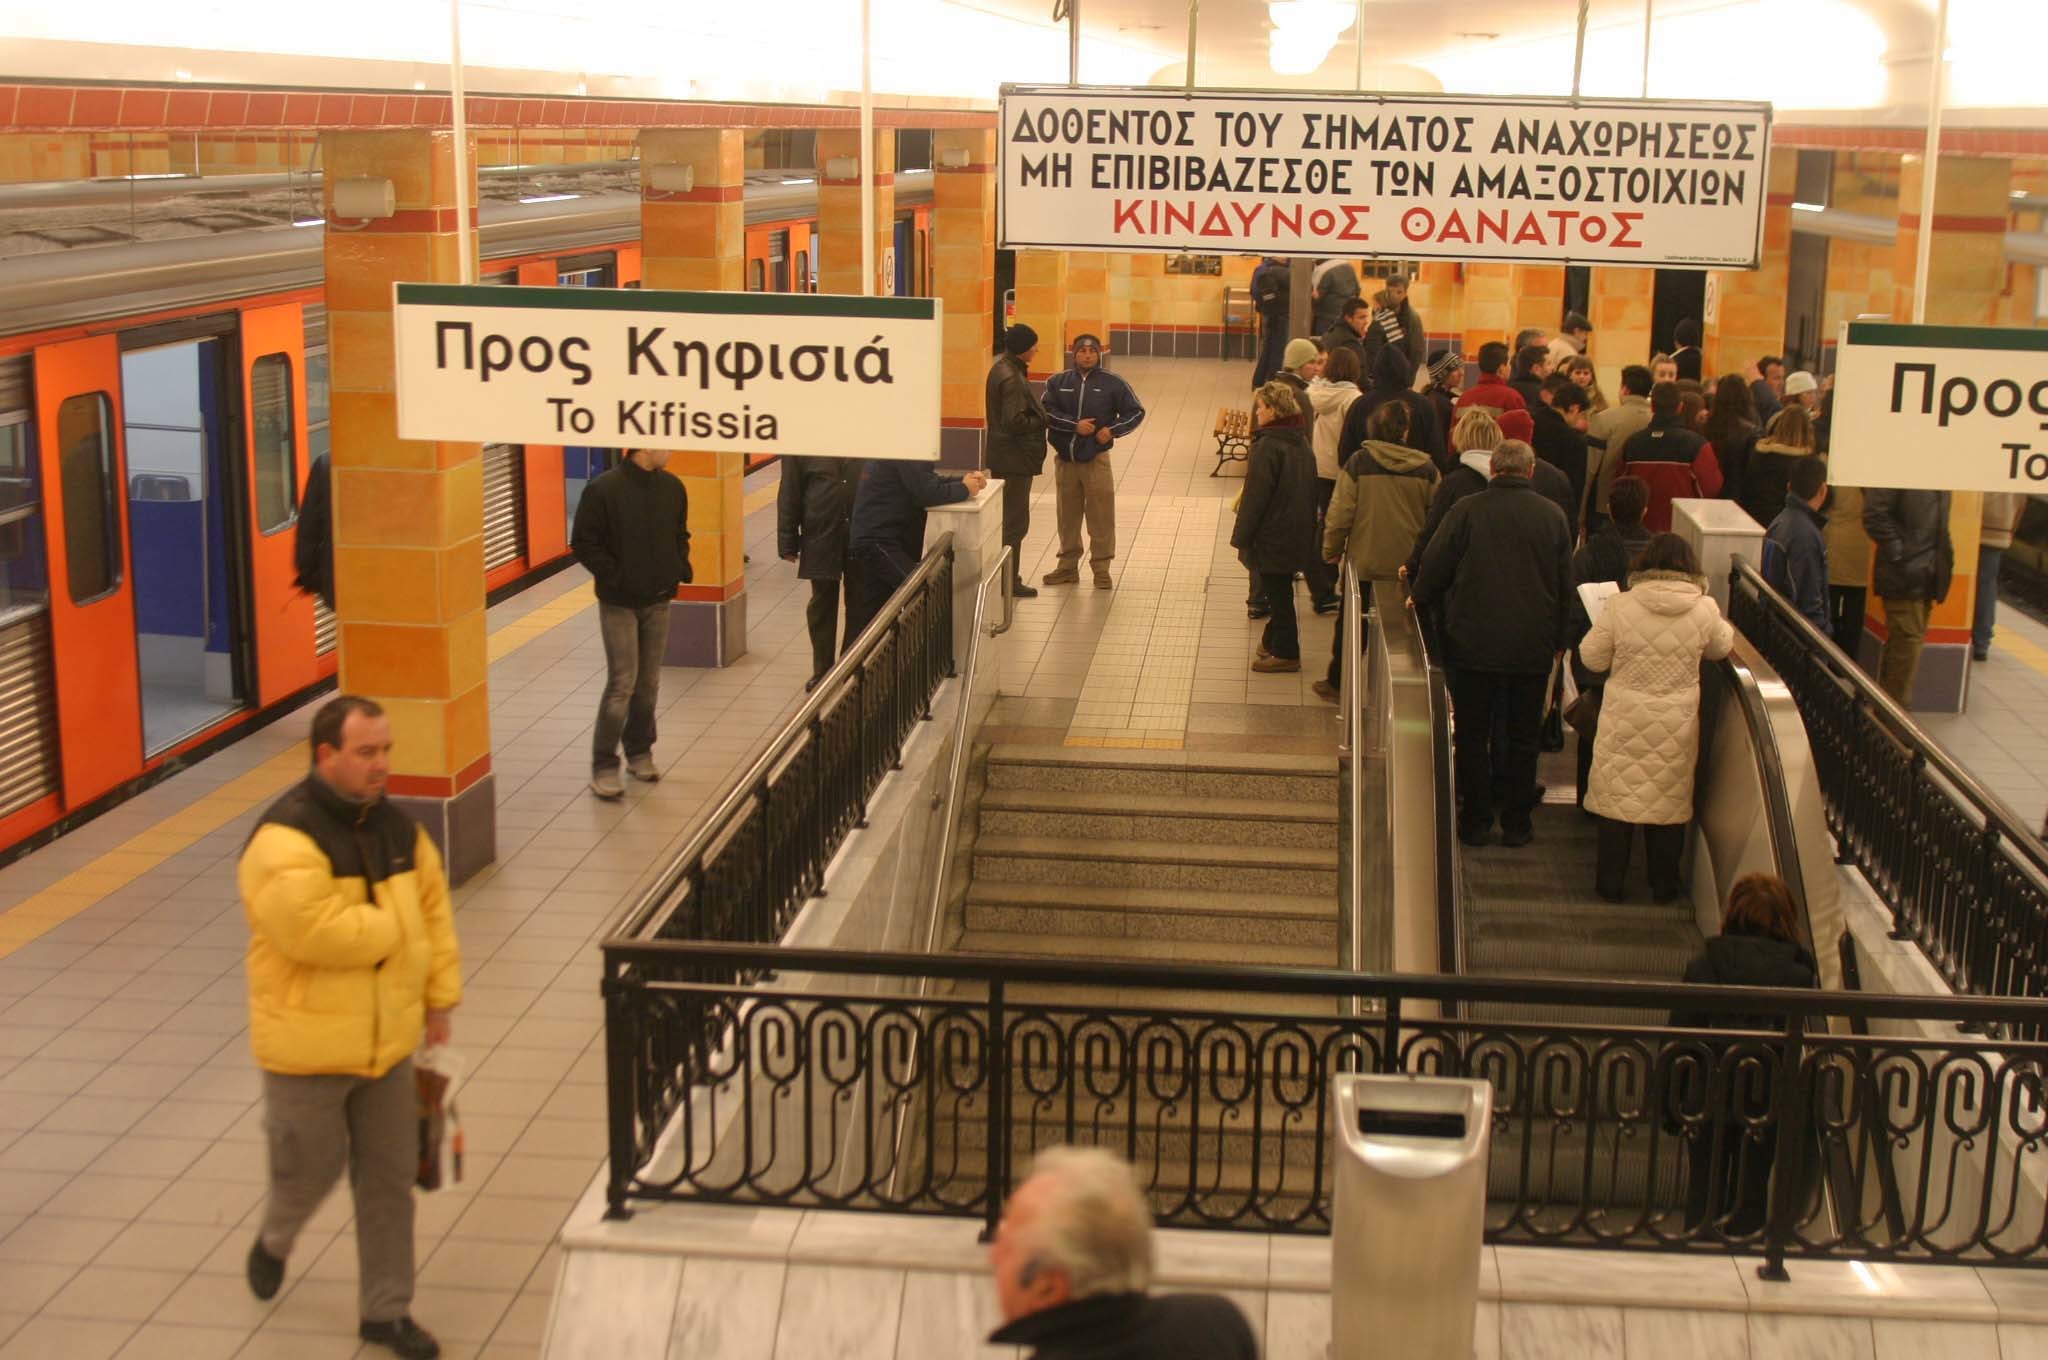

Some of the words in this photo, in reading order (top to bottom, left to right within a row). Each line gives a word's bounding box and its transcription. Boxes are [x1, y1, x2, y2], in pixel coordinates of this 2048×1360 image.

[1012, 107, 1195, 146] ΔΟΘΕΝΤΟΣ
[1214, 111, 1283, 148] ΤΟΥ
[1301, 114, 1474, 155] ΣΗΜΑΤΟΣ
[1490, 119, 1756, 161] ΑΝΑΧΩΡΗΣΕΩΣ
[1021, 152, 1072, 188] ΜΗ
[1091, 153, 1353, 195] ΕΠΙΒΙΒΑΖΕΣΘΕ
[1370, 160, 1435, 198] ΤΩΝ
[1450, 164, 1745, 206] ΑΜΑΞΟΣΤΟΙΧΙΩΝ
[1114, 199, 1371, 241] ΚΙΝΔΥΝΟΣ
[1400, 207, 1644, 249] ΘΑΝΑΤΟΣ
[435, 320, 593, 386] Προς
[627, 326, 894, 391] Κηφισιά
[546, 397, 595, 434] To
[618, 399, 778, 441] Kifissia
